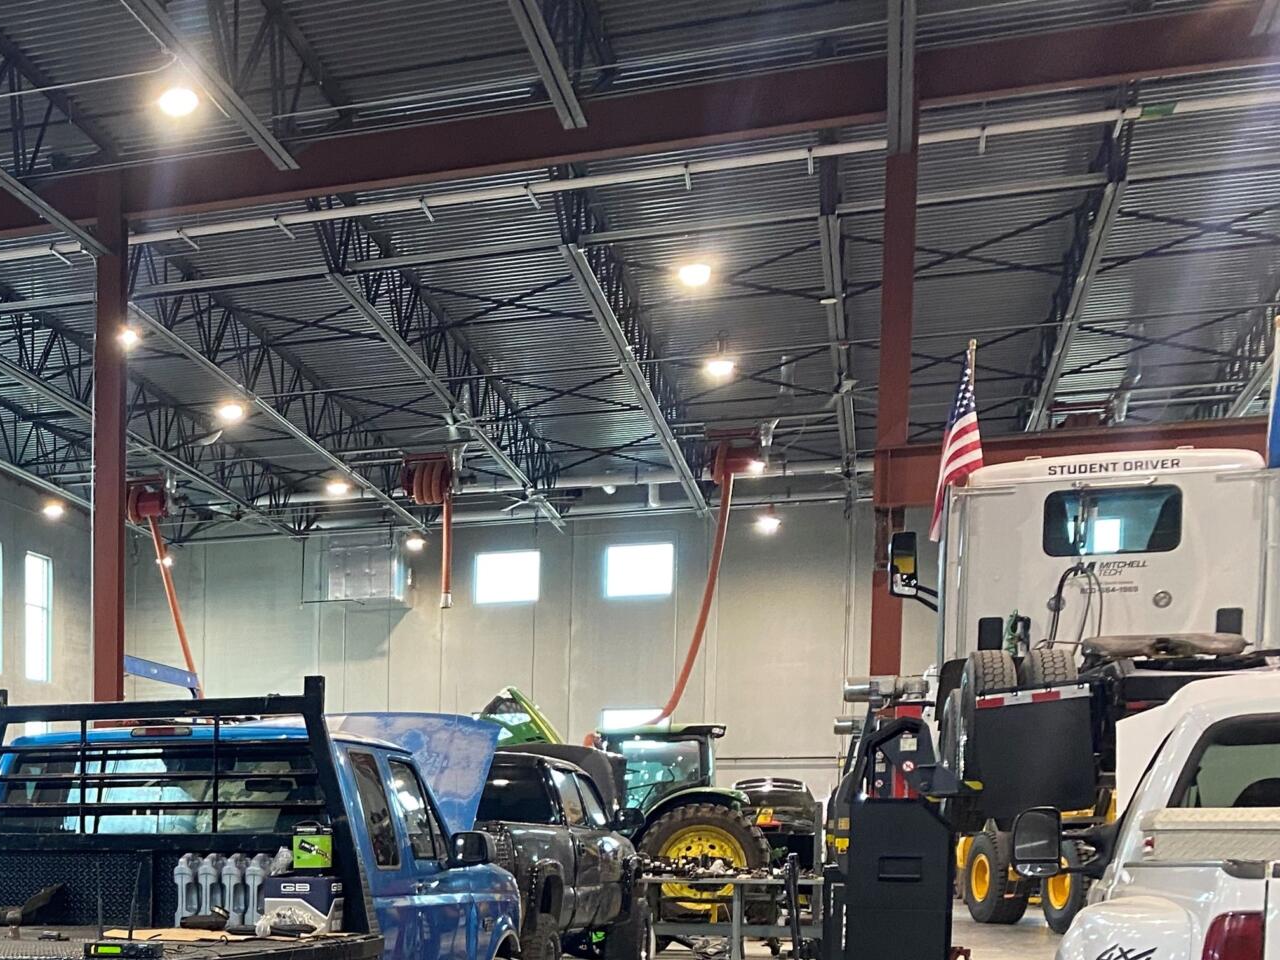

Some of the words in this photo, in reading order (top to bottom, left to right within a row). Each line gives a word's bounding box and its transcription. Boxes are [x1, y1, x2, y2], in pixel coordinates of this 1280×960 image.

[1048, 462, 1119, 475] STUDENT
[1123, 458, 1181, 471] DRIVER
[1099, 560, 1149, 569] MITCHELL
[1099, 568, 1123, 576] TECH
[281, 883, 310, 892] GB
